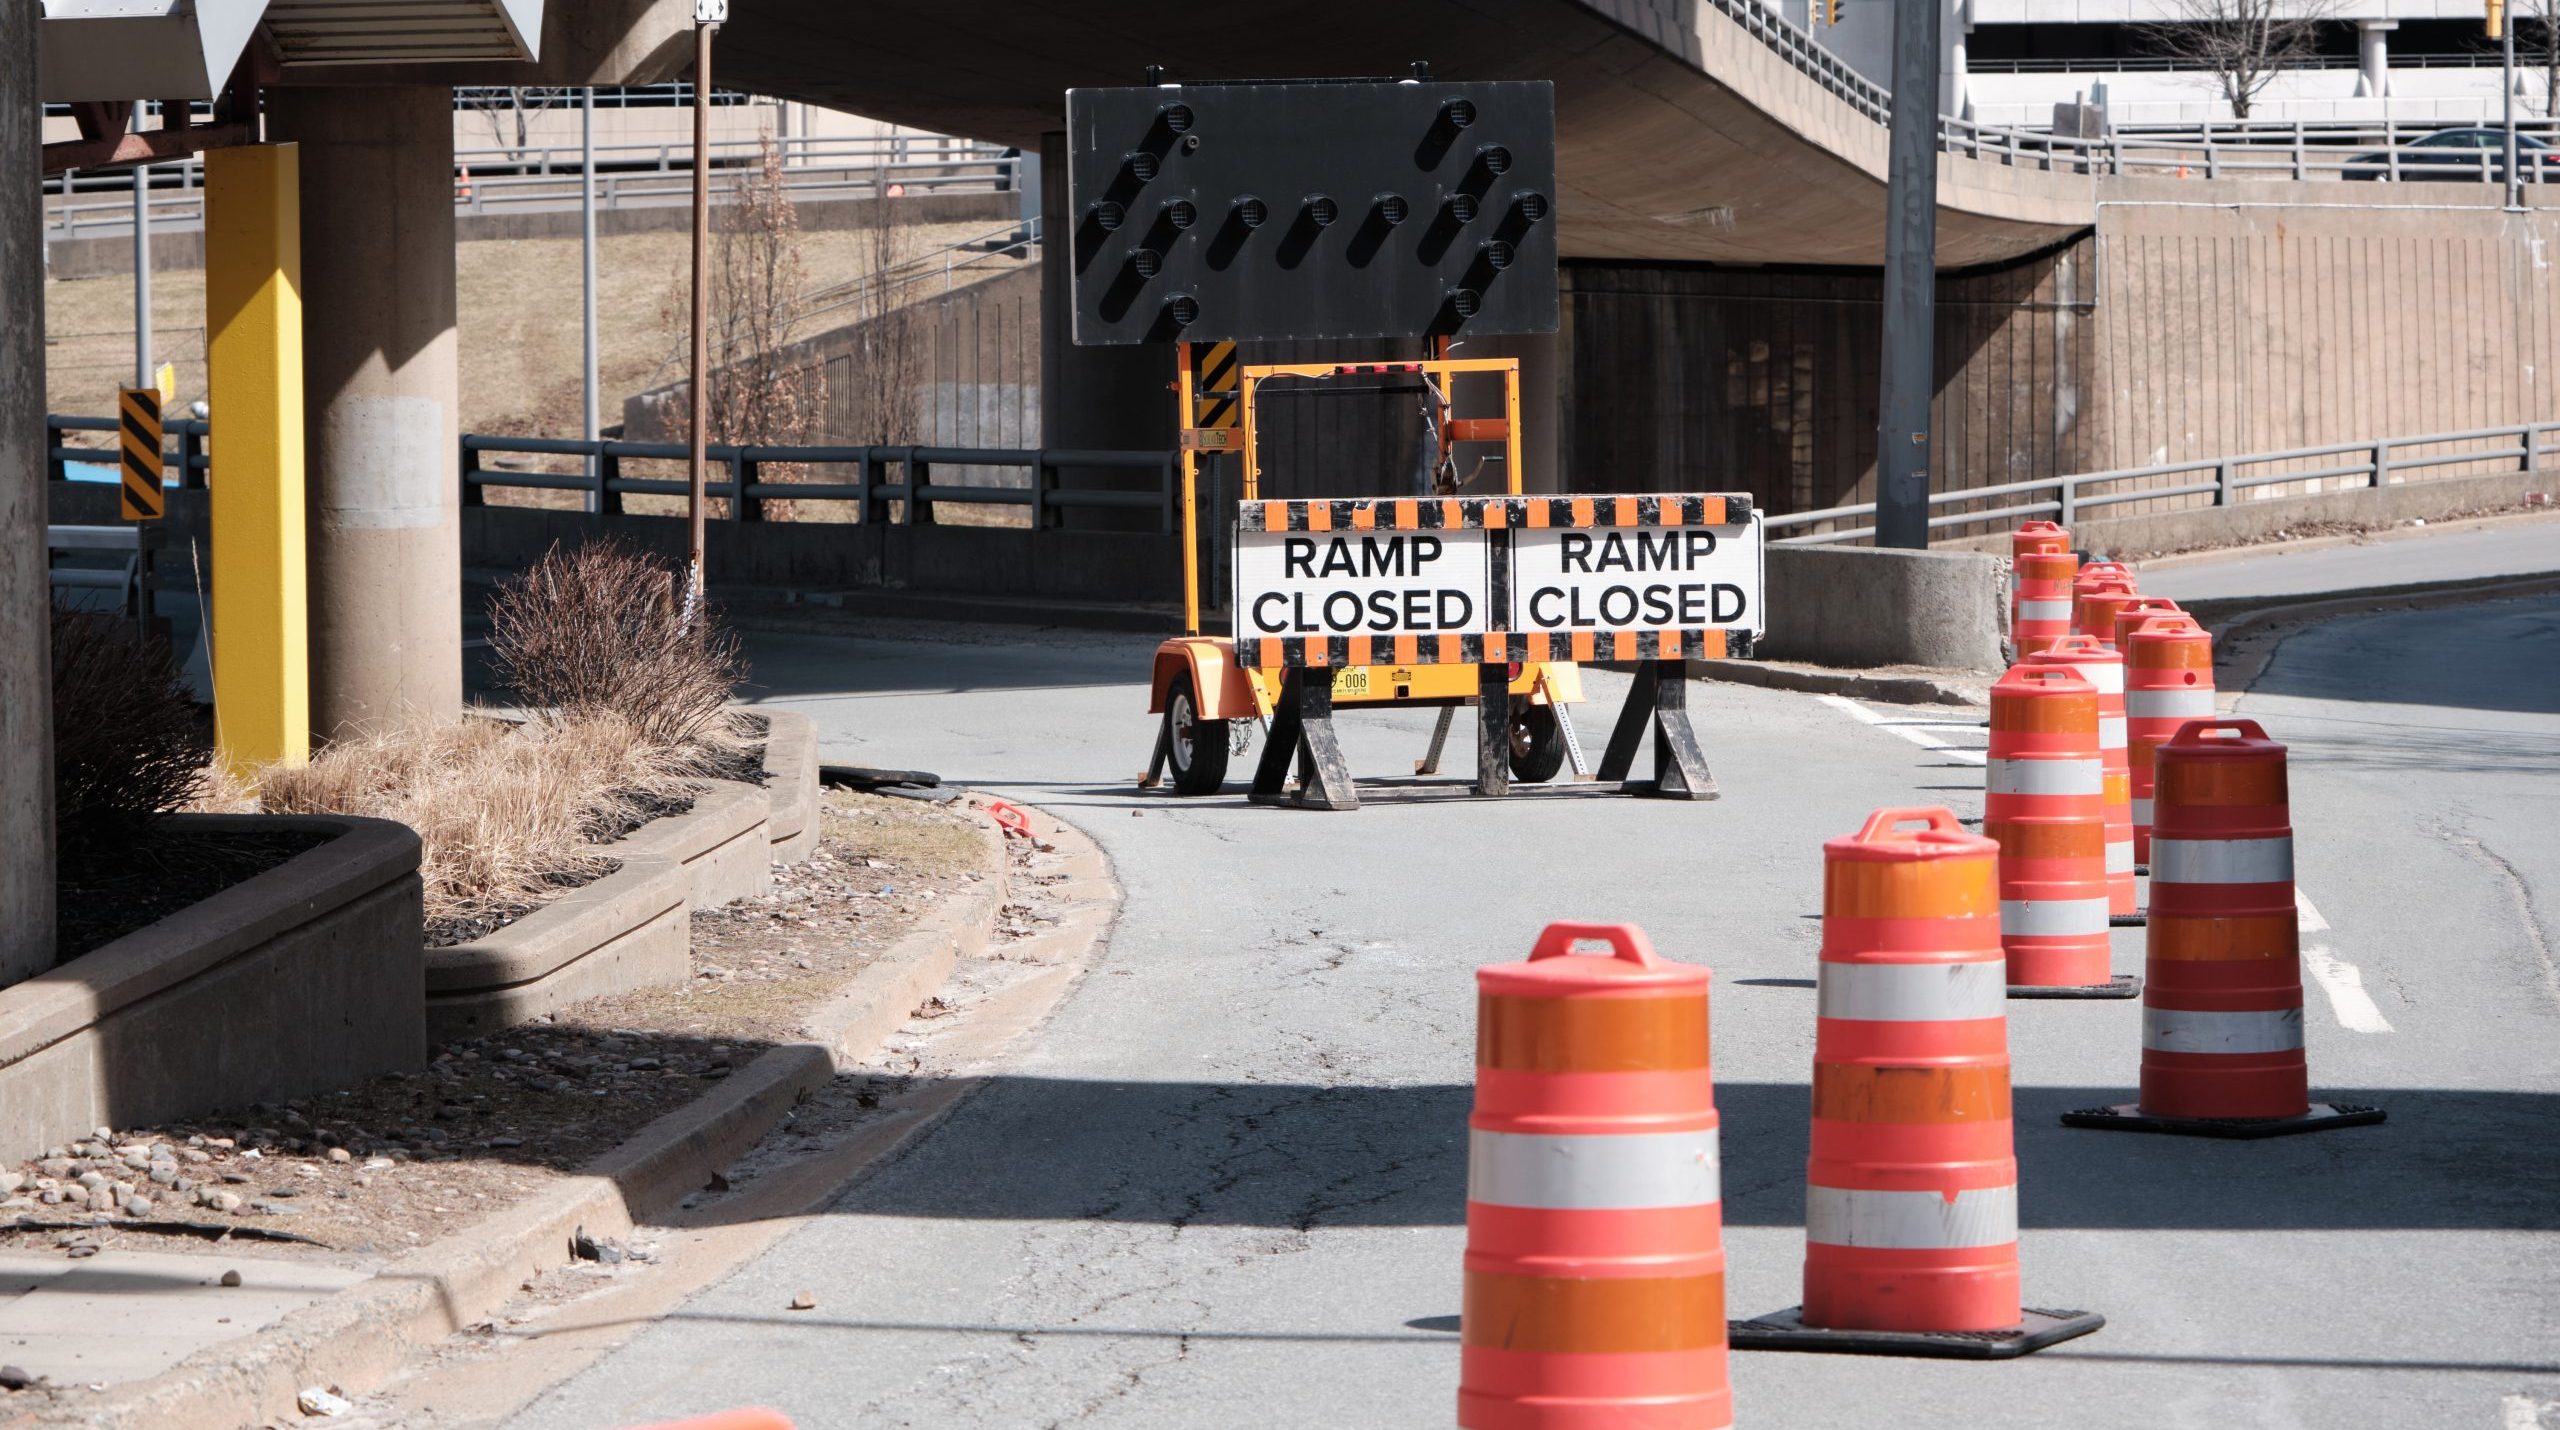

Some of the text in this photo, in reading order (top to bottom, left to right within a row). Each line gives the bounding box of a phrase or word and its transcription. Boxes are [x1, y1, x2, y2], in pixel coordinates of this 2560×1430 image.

[1285, 535, 1443, 579] RAMP
[1561, 529, 1717, 573] RAMP
[1252, 589, 1473, 633] CLOSED
[1529, 583, 1746, 627] CLOSED
